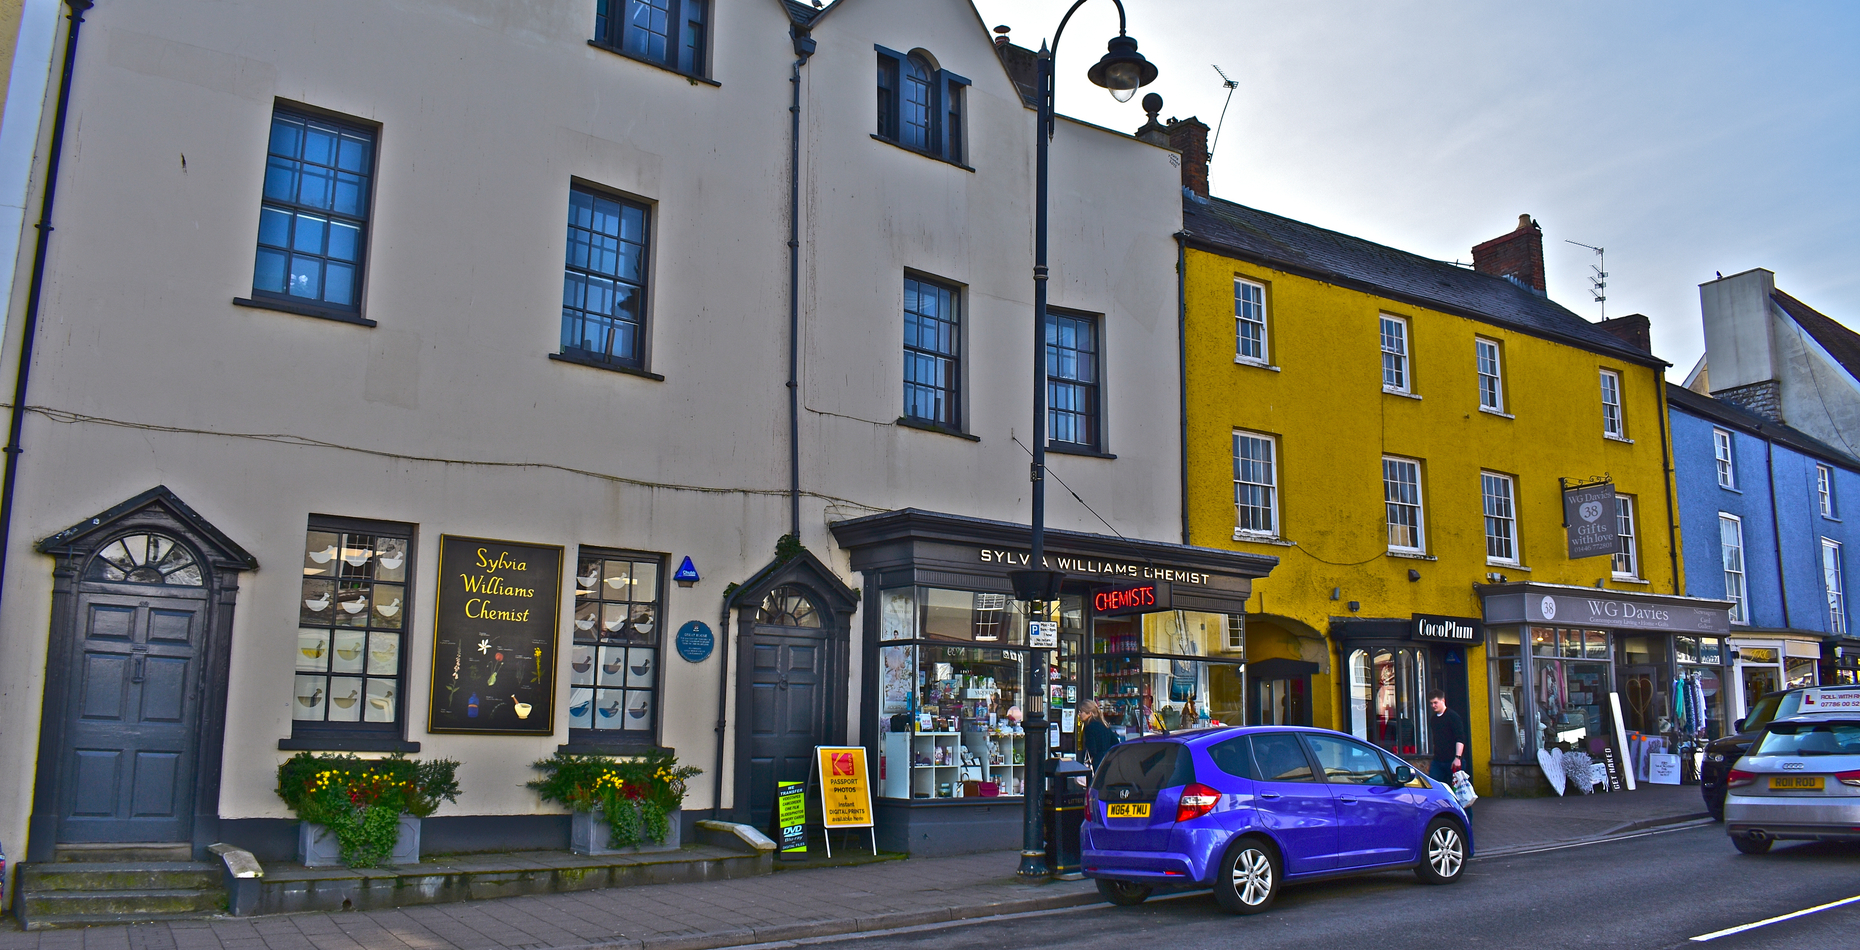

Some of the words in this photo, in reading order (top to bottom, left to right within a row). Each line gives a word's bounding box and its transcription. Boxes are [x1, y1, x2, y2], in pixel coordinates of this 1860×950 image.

[1568, 494, 1583, 504] WG
[1585, 489, 1611, 502] Davies
[1584, 505, 1598, 518] 38
[1577, 523, 1607, 535] Gifts
[1572, 535, 1593, 545] with
[1594, 533, 1613, 543] love
[476, 548, 527, 573] Sylvia
[981, 549, 1049, 568] SYLVA
[1057, 557, 1137, 577] WILLIAMS
[1144, 567, 1209, 585] CHEMIST
[460, 573, 534, 598] Williams
[1095, 586, 1155, 611] CHEMISTS
[465, 598, 530, 622] Chemist
[1543, 601, 1554, 614] 38
[1587, 600, 1617, 617] WG
[1622, 602, 1669, 621] Davies
[1419, 618, 1473, 639] CocoPlum
[1805, 695, 1815, 704] L
[1604, 747, 1616, 773] NAKED
[1611, 775, 1620, 790] GET
[1796, 777, 1815, 786] ROD
[780, 788, 803, 796] TRANSFER
[1132, 804, 1147, 815] TMU
[783, 825, 802, 835] DVD
